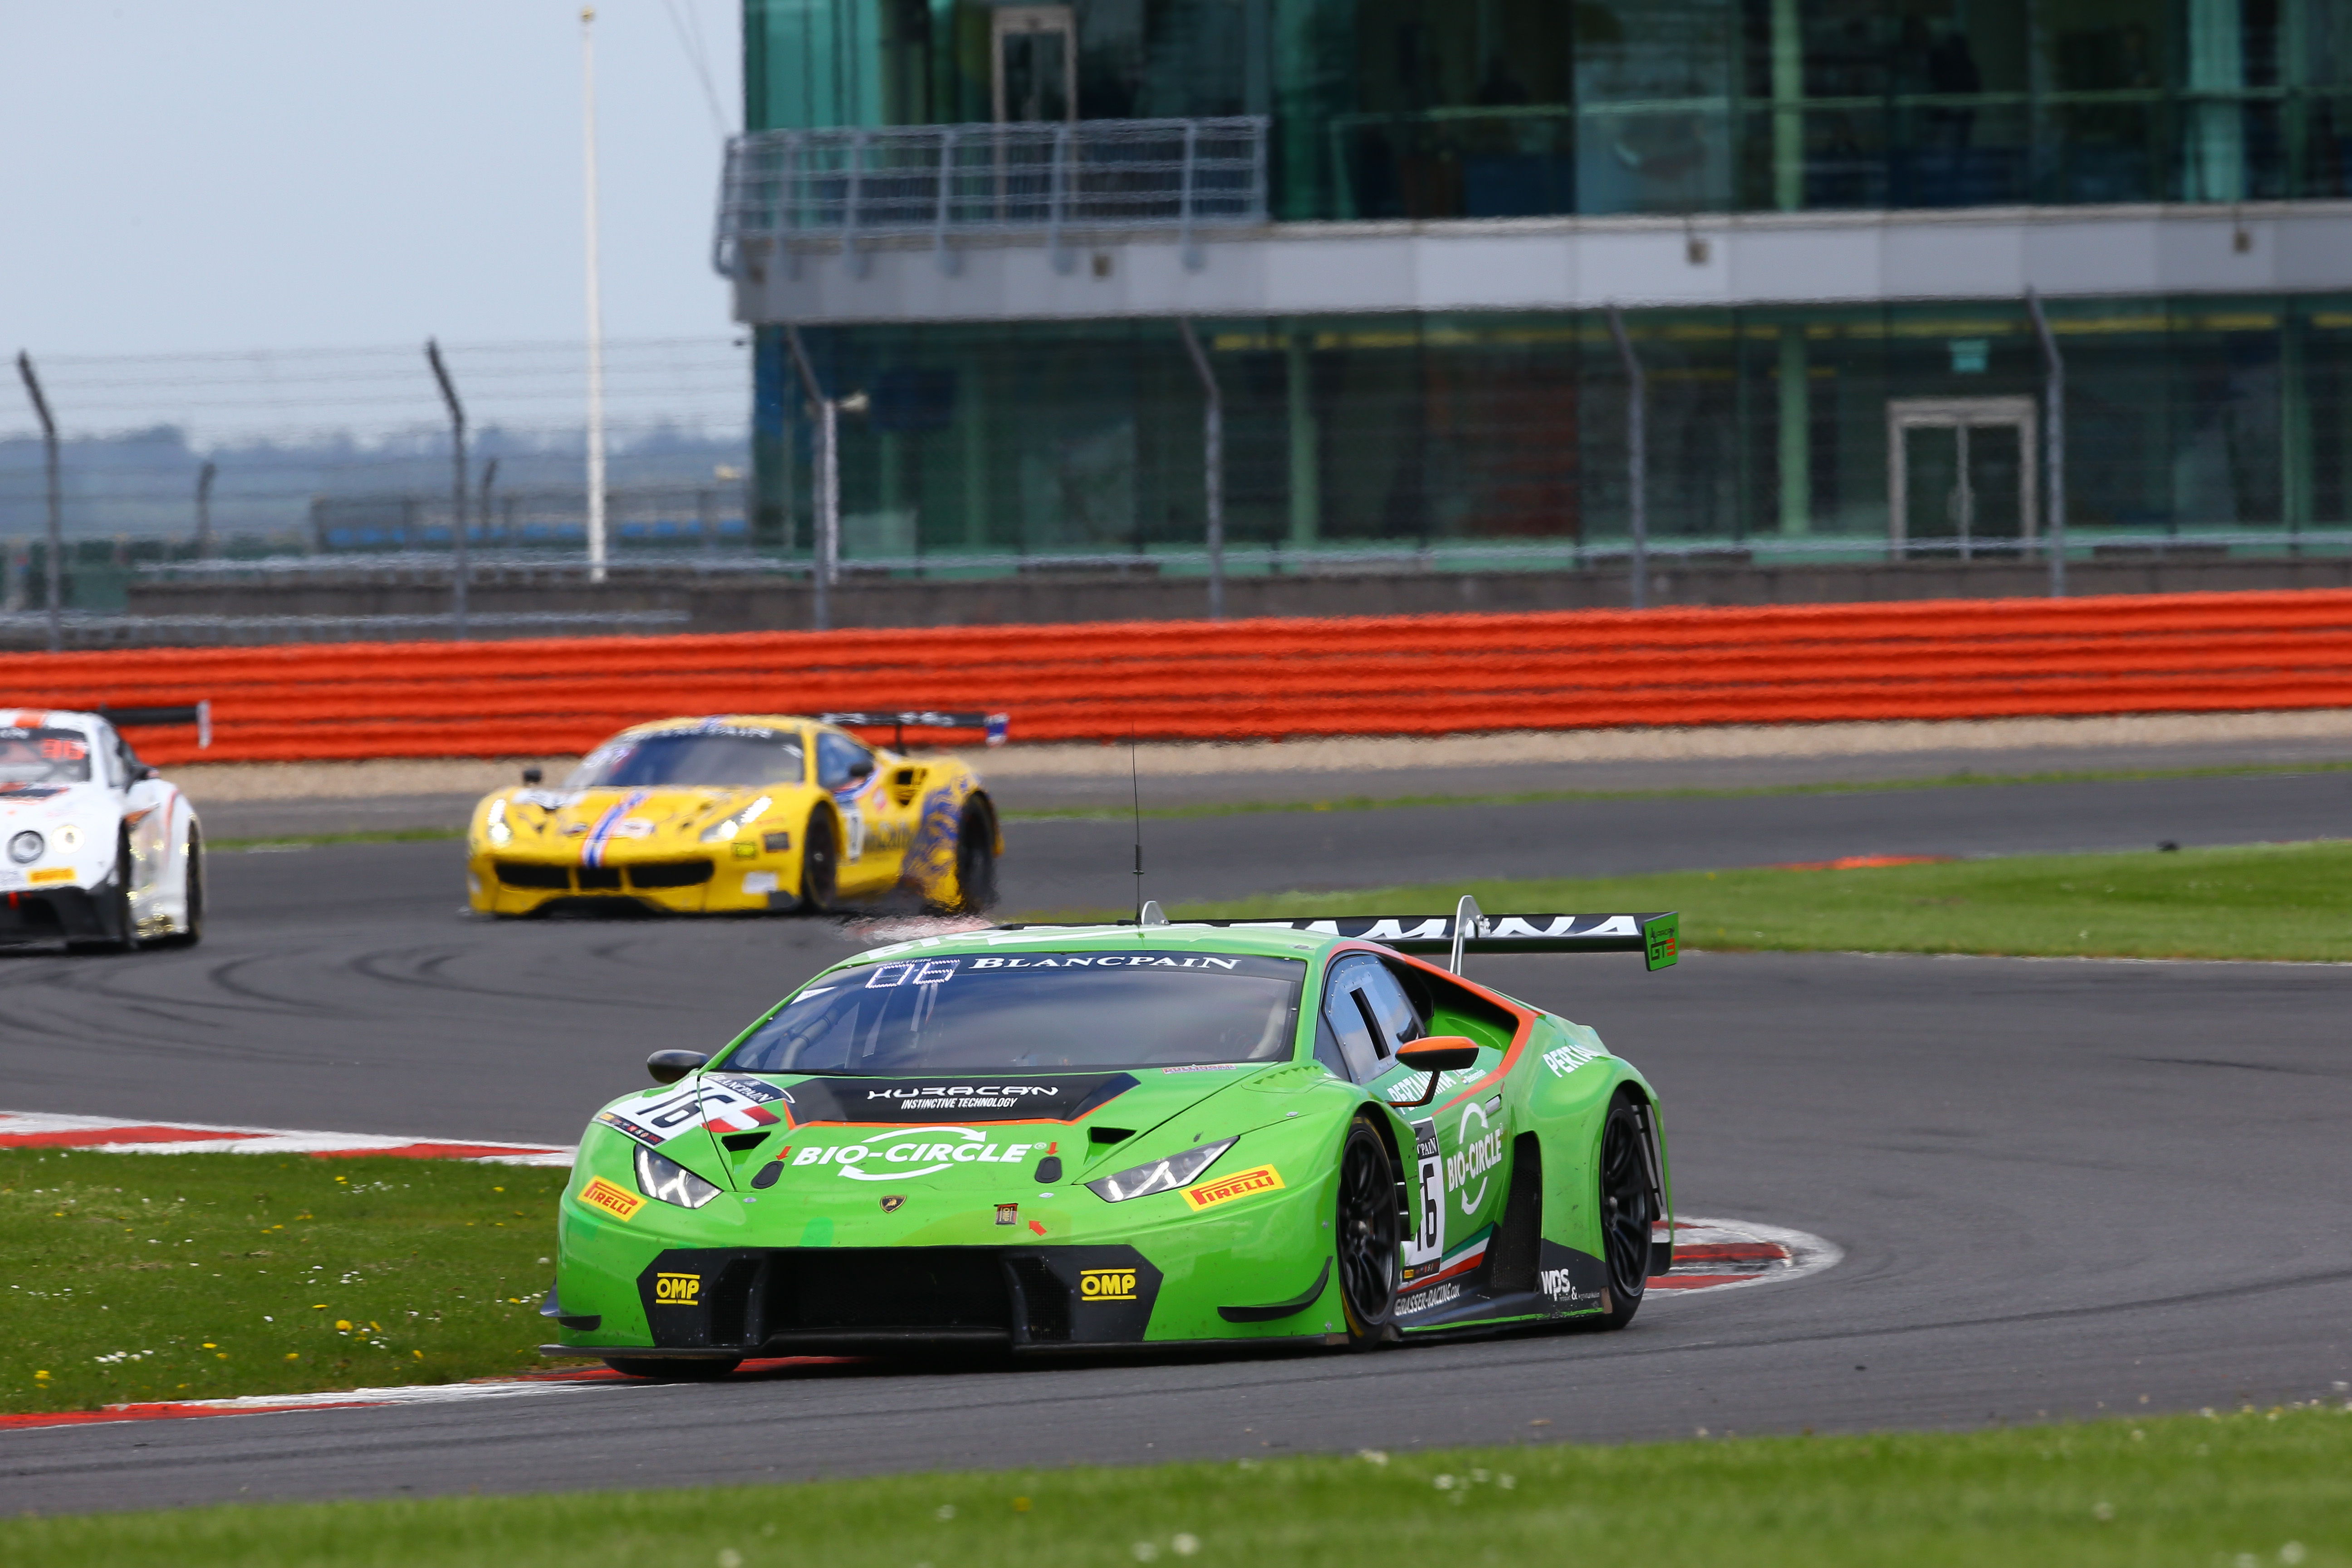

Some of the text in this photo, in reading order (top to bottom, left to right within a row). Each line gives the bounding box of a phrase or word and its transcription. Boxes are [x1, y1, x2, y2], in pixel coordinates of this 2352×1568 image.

[1651, 938, 1675, 961] GT3
[968, 956, 1242, 970] BLANCPAIN
[636, 1086, 737, 1128] 16
[901, 1097, 1018, 1110] INSTINCTIVE TECHNOLOGY
[583, 1180, 638, 1215] PIRELLI
[1189, 1170, 1274, 1205] PIRELLI
[656, 1278, 699, 1299] OMP
[1081, 1274, 1136, 1295] OMP
